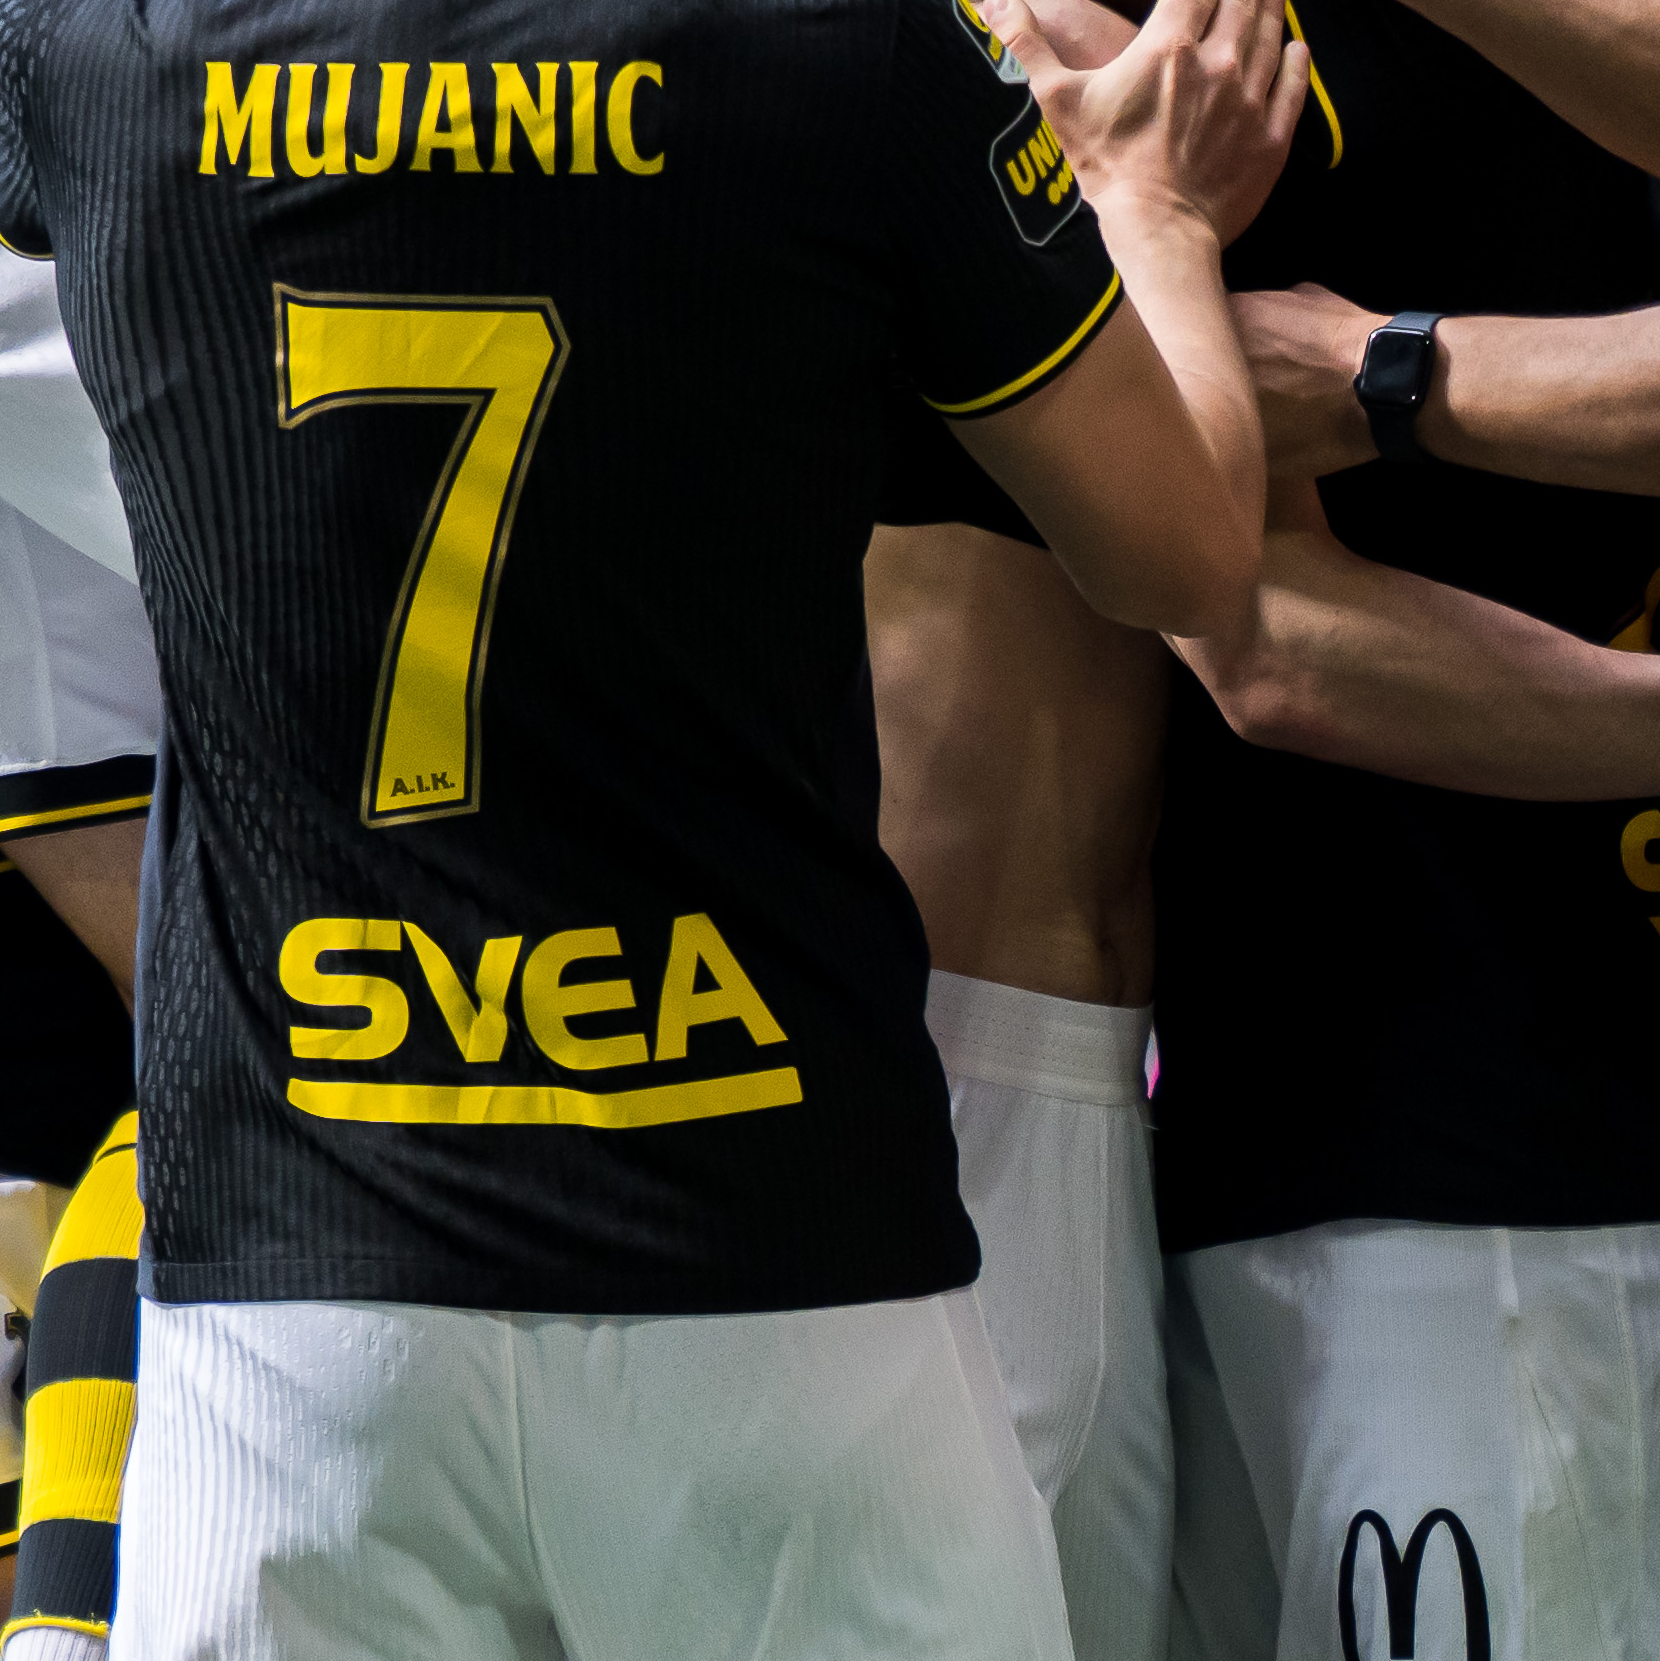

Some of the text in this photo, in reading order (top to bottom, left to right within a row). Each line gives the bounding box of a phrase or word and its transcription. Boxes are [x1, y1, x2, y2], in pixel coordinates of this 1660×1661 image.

[199, 60, 665, 178] MUJANIC
[1006, 116, 1062, 196] UNI
[274, 284, 570, 828] 7
[390, 772, 456, 797] A.I.K.
[278, 912, 789, 1071] SVEA
